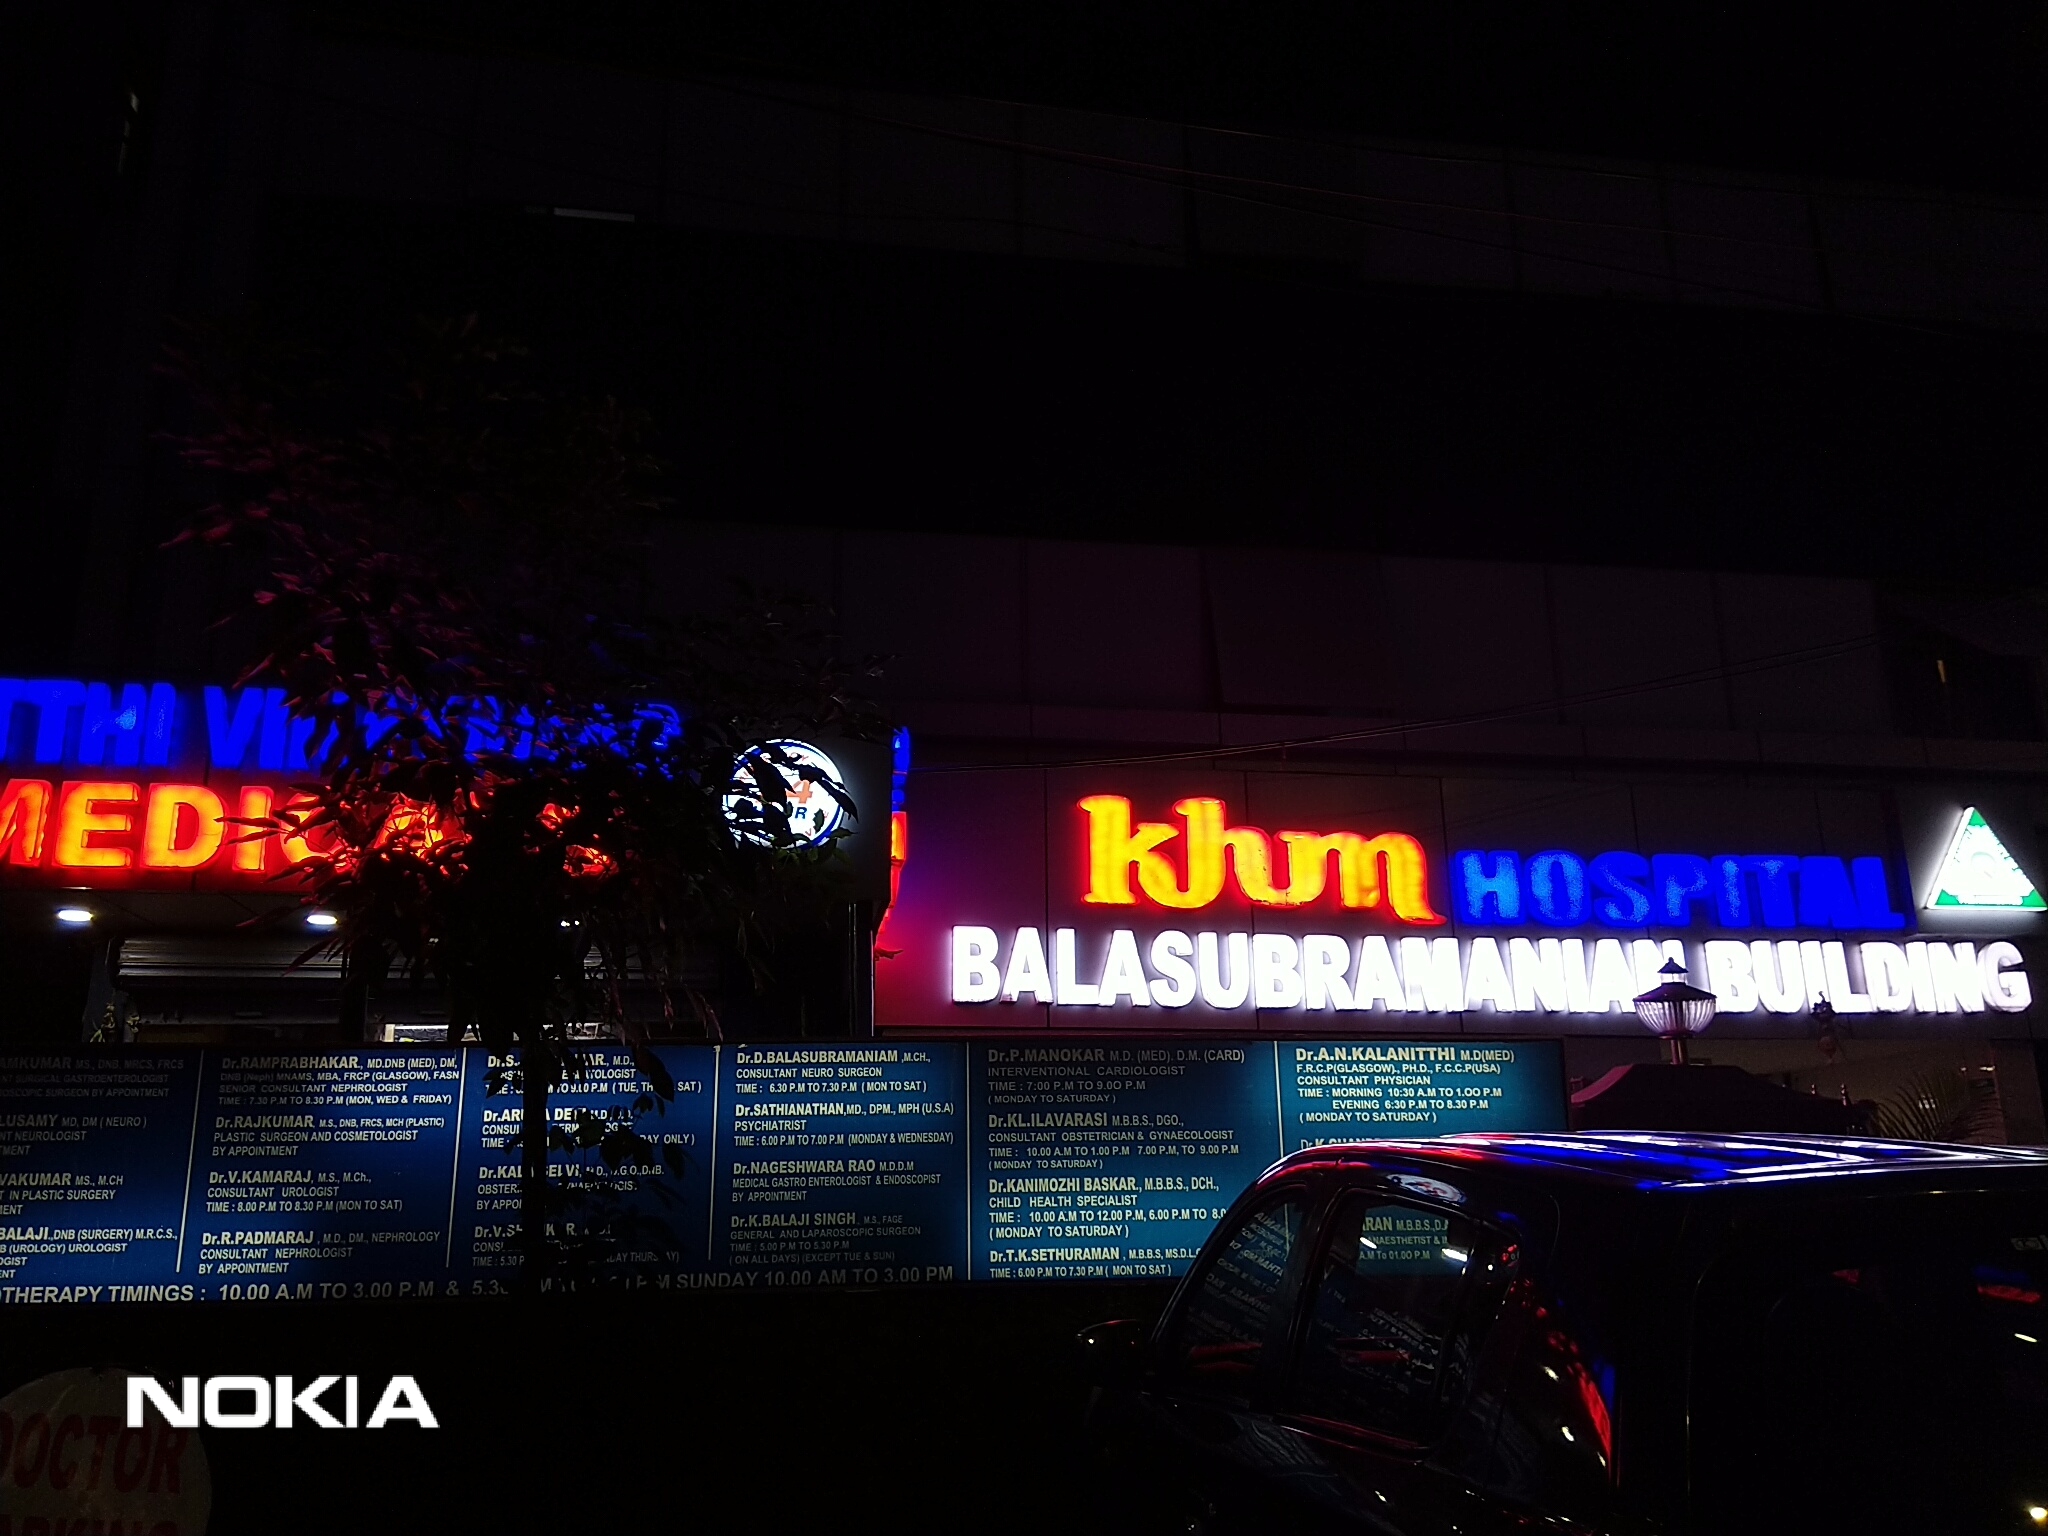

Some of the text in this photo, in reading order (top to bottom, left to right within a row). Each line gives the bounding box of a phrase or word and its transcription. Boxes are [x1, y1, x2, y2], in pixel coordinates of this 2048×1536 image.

[1452, 849, 1907, 931] HOSPITAL
[951, 924, 2033, 1015] BALASUBRAMANIAN BUILDING
[737, 1050, 898, 1064] Dr.D.BALASUBRAMANIAM
[988, 1049, 1105, 1062] Dr.P.MANOKAR
[1204, 1049, 1245, 1063] (CARD)
[1296, 1047, 1455, 1062] Dr.A.N.KALANITTHI
[407, 1058, 437, 1070] (MED),
[1435, 1063, 1501, 1075] F.C.C.P(USA)
[317, 1072, 341, 1082] MBA,
[344, 1072, 370, 1080] FRCP
[372, 1071, 431, 1082] (GLASGOW),
[433, 1071, 459, 1079] FASN
[736, 1067, 882, 1078] CONSULTANT NEURO SURGEON
[988, 1065, 1185, 1077] INTERVENTIONAL CARDIOLOGIST
[1297, 1075, 1430, 1085] CONSULTANT PHYSICIAN
[219, 1083, 407, 1093] SENIOR CONSULTANT NEPHROLOGIST
[678, 1082, 695, 1091] SAT
[770, 1081, 921, 1093] 6.30 P.M TO 7.30 P.M MON TO SAT
[1332, 1088, 1382, 1097] MORNING
[1388, 1088, 1414, 1097] 10:30
[1417, 1088, 1436, 1097] A.M
[1438, 1088, 1453, 1097] TO
[1483, 1088, 1502, 1097] P.M
[326, 1096, 343, 1105] P.M
[346, 1096, 374, 1106] (MON,
[413, 1095, 452, 1104] FRIDAY)
[1332, 1100, 1488, 1109] EVENING 6:30 P.M TO 8.30 P.M
[898, 1104, 919, 1114] MPH
[386, 1118, 404, 1127] MCH
[406, 1117, 444, 1128] (PLASTIC)
[735, 1120, 806, 1131] PSYCHIATRIST
[989, 1112, 1107, 1128] Dr.KL.ILAVARASI
[15, 1131, 87, 1141] NEUROLOGIST
[214, 1131, 418, 1142] PLASTIC SURGEON AND COSMETOLOGIST
[664, 1134, 689, 1144] ONLY
[848, 1133, 888, 1146] (MONDAY
[898, 1132, 953, 1144] WEDNESDAY)
[988, 1132, 1056, 1143] CONSULTANT
[1062, 1131, 1135, 1142] OBSTETRICIAN
[1150, 1130, 1234, 1141] GYNAECOLOGIST
[212, 1146, 298, 1156] BY APPOINTMENT
[734, 1160, 844, 1175] Dr.NAGESHWARA
[849, 1159, 875, 1172] RAO
[98, 1175, 123, 1185] M.CH
[732, 1177, 769, 1188] MEDICAL
[772, 1177, 806, 1188] GASTRO
[809, 1175, 871, 1186] ENTEROLOGIST
[883, 1174, 941, 1185] ENDOSCOPIST
[989, 1177, 1080, 1193] Dr.KANIMOZHI
[10, 1190, 116, 1200] IN PLASTIC SURGERY
[208, 1187, 339, 1197] CONSULTANT UROLOGIST
[476, 1201, 489, 1210] BY
[989, 1195, 1137, 1208] CHILD HEALTH SPECIALIST
[731, 1215, 809, 1227] Dr.K.BALAJI
[77, 1229, 133, 1241] (SURGERY)
[372, 1232, 440, 1242] NEPHROLOGY
[730, 1226, 921, 1240] GENERAL AND LAPAROSCOPIC SURGEON
[9, 1243, 127, 1254] (UROLOGY) UROLOGIST
[990, 1247, 1119, 1263] Dr.T.K.SETHURAMAN
[198, 1263, 289, 1274] BY APPOINTMENT
[0, 1266, 953, 1303] THERAPY TIMINGS 10.00 A.M TO 3.00 P.M SUNDAY 10.00 AM TO 3.00 PM
